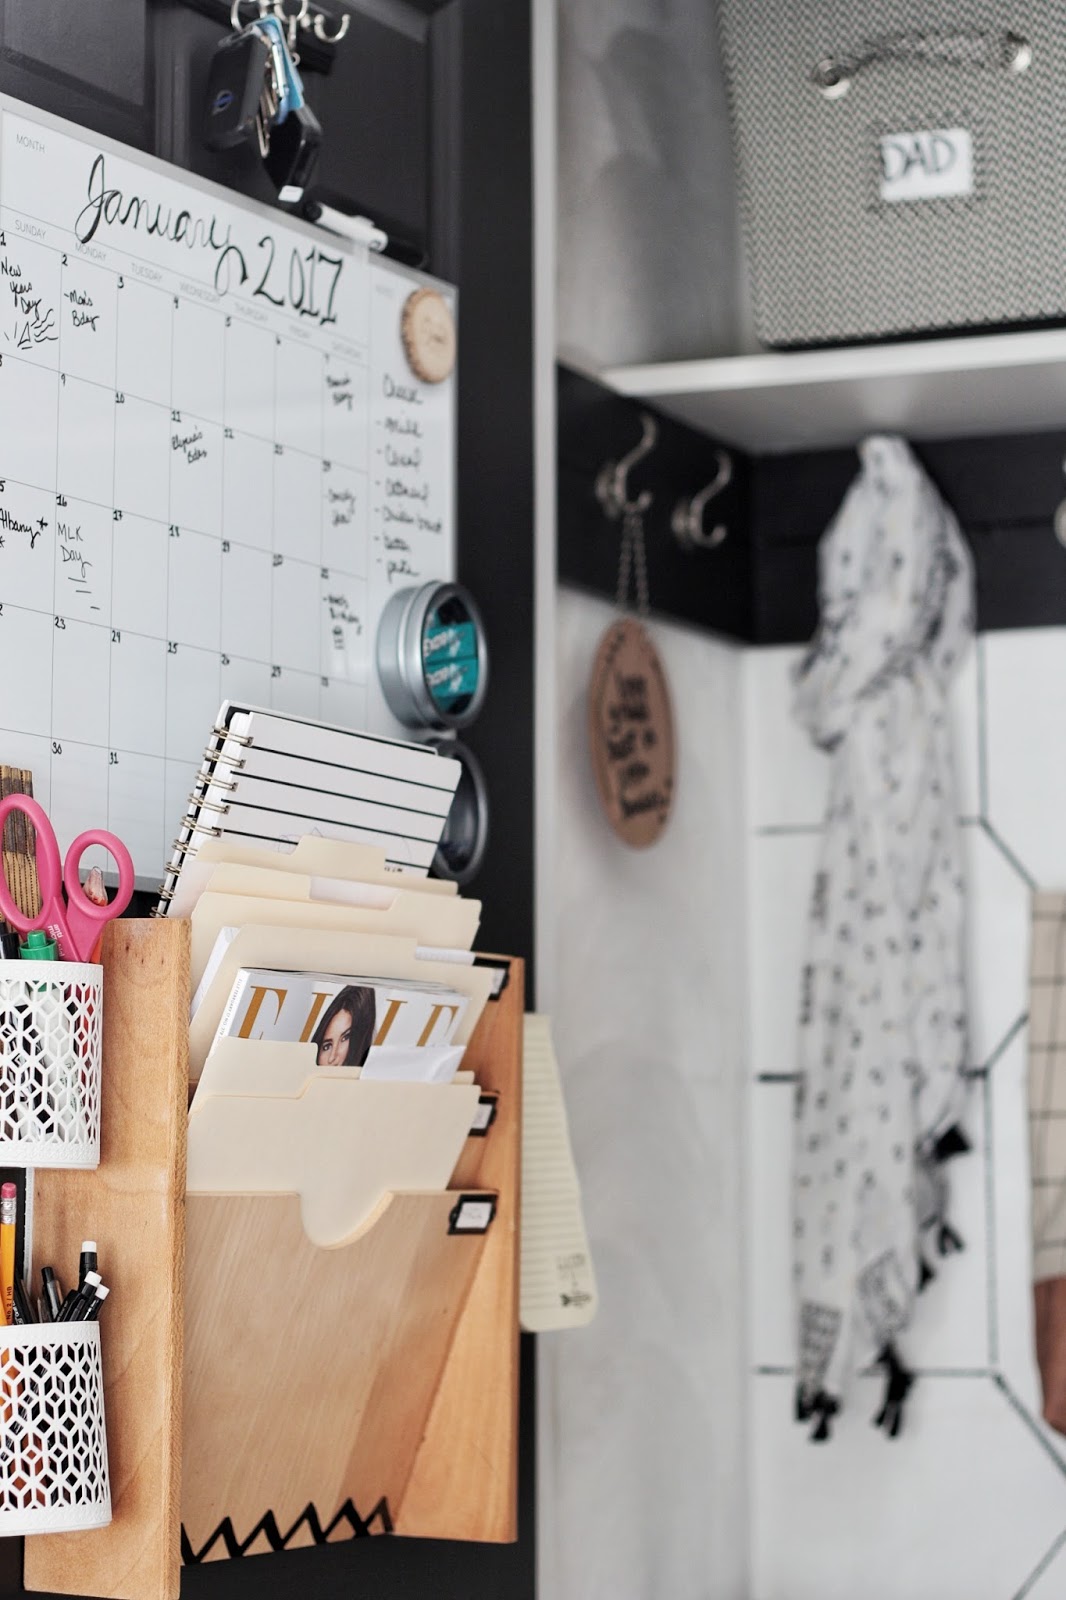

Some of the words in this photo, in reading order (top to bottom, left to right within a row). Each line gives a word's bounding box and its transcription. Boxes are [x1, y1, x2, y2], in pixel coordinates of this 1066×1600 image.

[16, 133, 46, 153] MONTH
[881, 135, 956, 182] DAD
[15, 219, 46, 239] SUNDAY
[75, 153, 248, 296] January
[253, 236, 343, 325] 2017
[74, 241, 106, 260] MONDAY
[1, 256, 22, 277] New
[61, 253, 68, 267] 2
[117, 276, 124, 289] 3
[171, 410, 182, 423] 11
[56, 493, 68, 507] 16
[112, 509, 123, 521] 17
[57, 522, 84, 542] MLK
[60, 544, 93, 579] Day
[54, 616, 66, 629] 23
[111, 629, 121, 643] 24
[51, 741, 63, 755] 30
[108, 751, 119, 765] 31
[53, 923, 64, 938] anti
[238, 985, 459, 1047] ELLE
